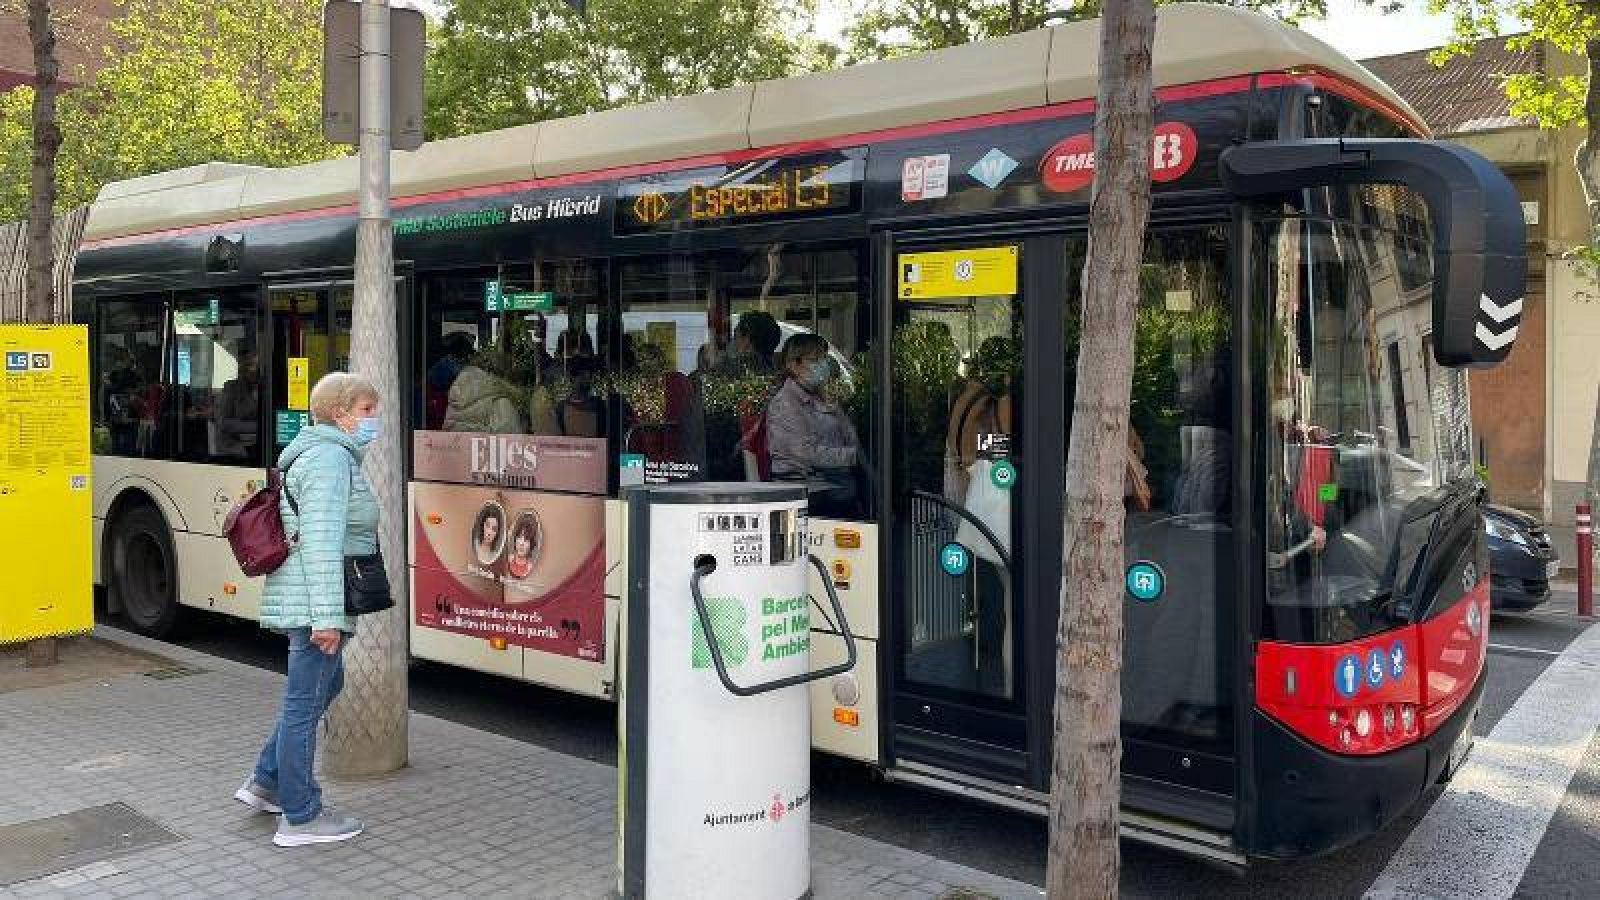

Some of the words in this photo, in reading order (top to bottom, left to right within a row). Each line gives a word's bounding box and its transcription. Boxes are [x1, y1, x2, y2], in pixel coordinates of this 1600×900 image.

[690, 169, 788, 220] Especial
[509, 203, 543, 223] Bus
[471, 436, 537, 474] Elles
[762, 618, 787, 642] pel
[703, 809, 765, 827] Ajuntament
